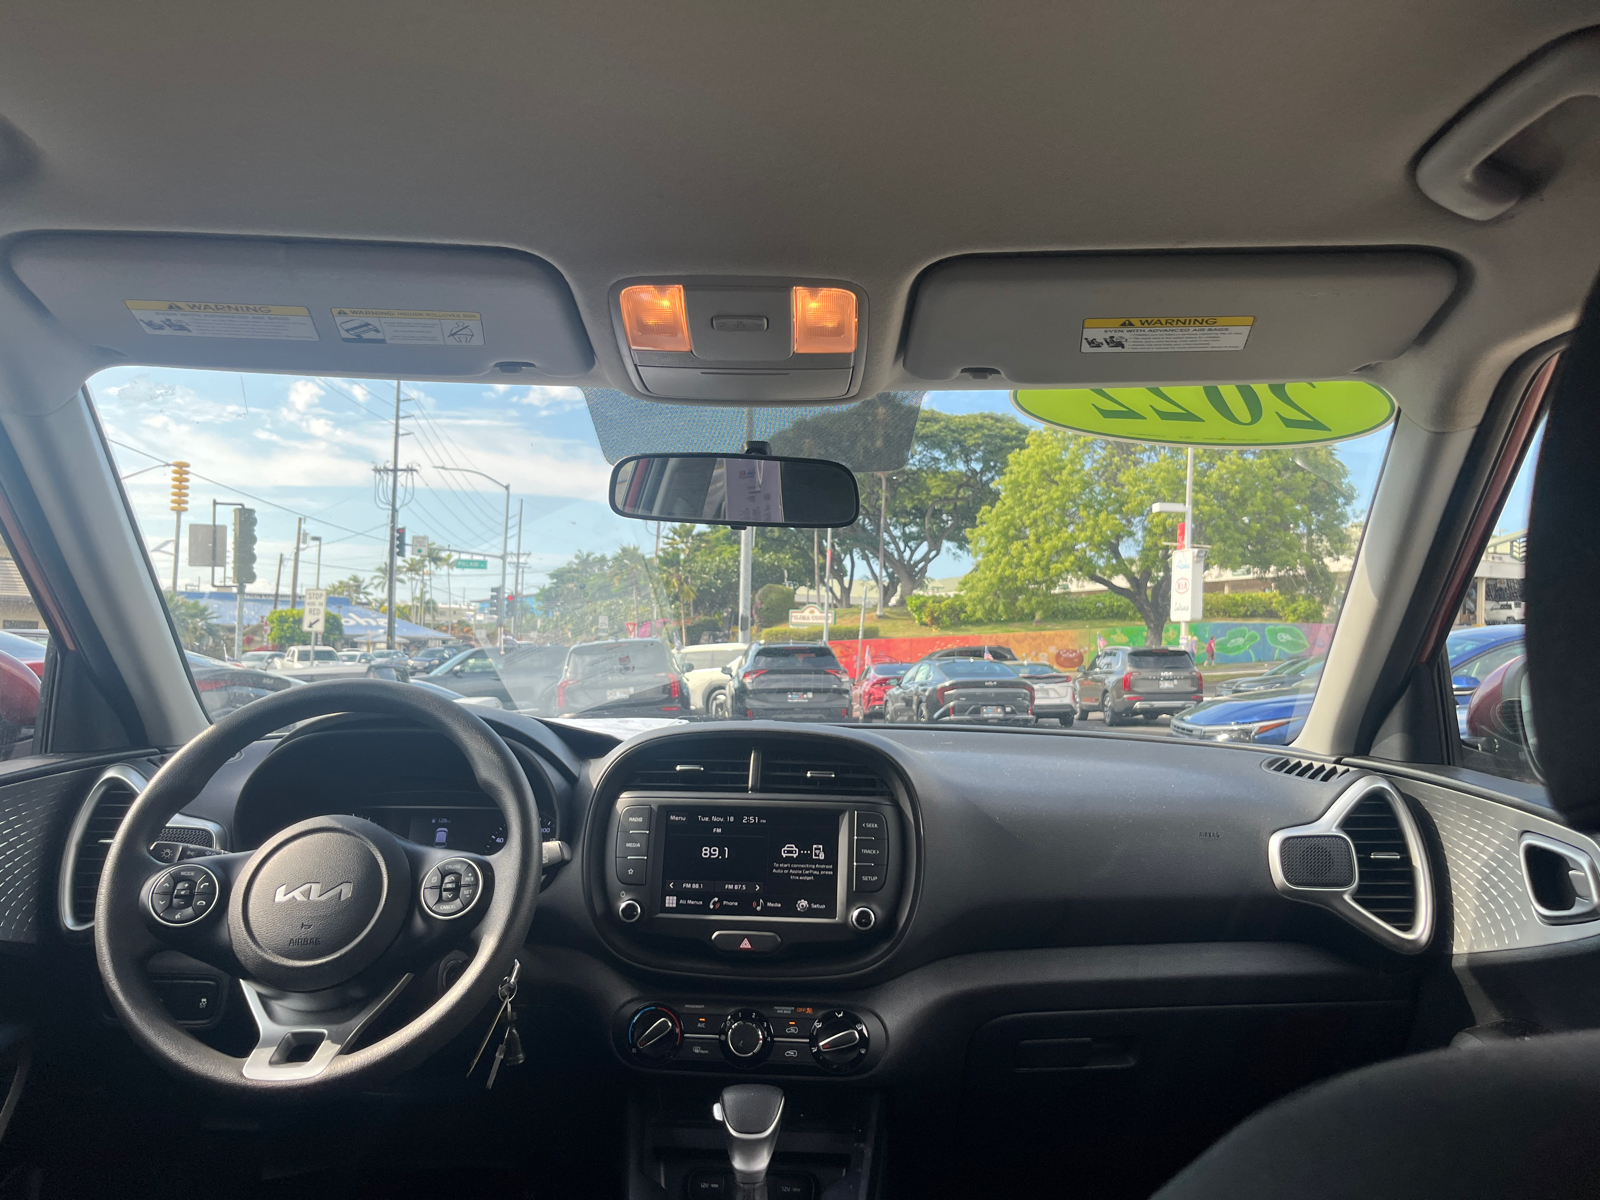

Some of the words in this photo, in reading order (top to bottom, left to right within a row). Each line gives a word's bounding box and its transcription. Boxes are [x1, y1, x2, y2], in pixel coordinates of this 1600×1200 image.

[186, 303, 272, 314] WARNING
[1139, 318, 1218, 326] WARNING
[1177, 582, 1188, 590] KIA
[308, 592, 324, 600] STOP
[308, 607, 321, 616] RED
[701, 847, 729, 859] 89.1
[274, 882, 353, 903] KIA
[289, 938, 321, 946] AIRBAG
